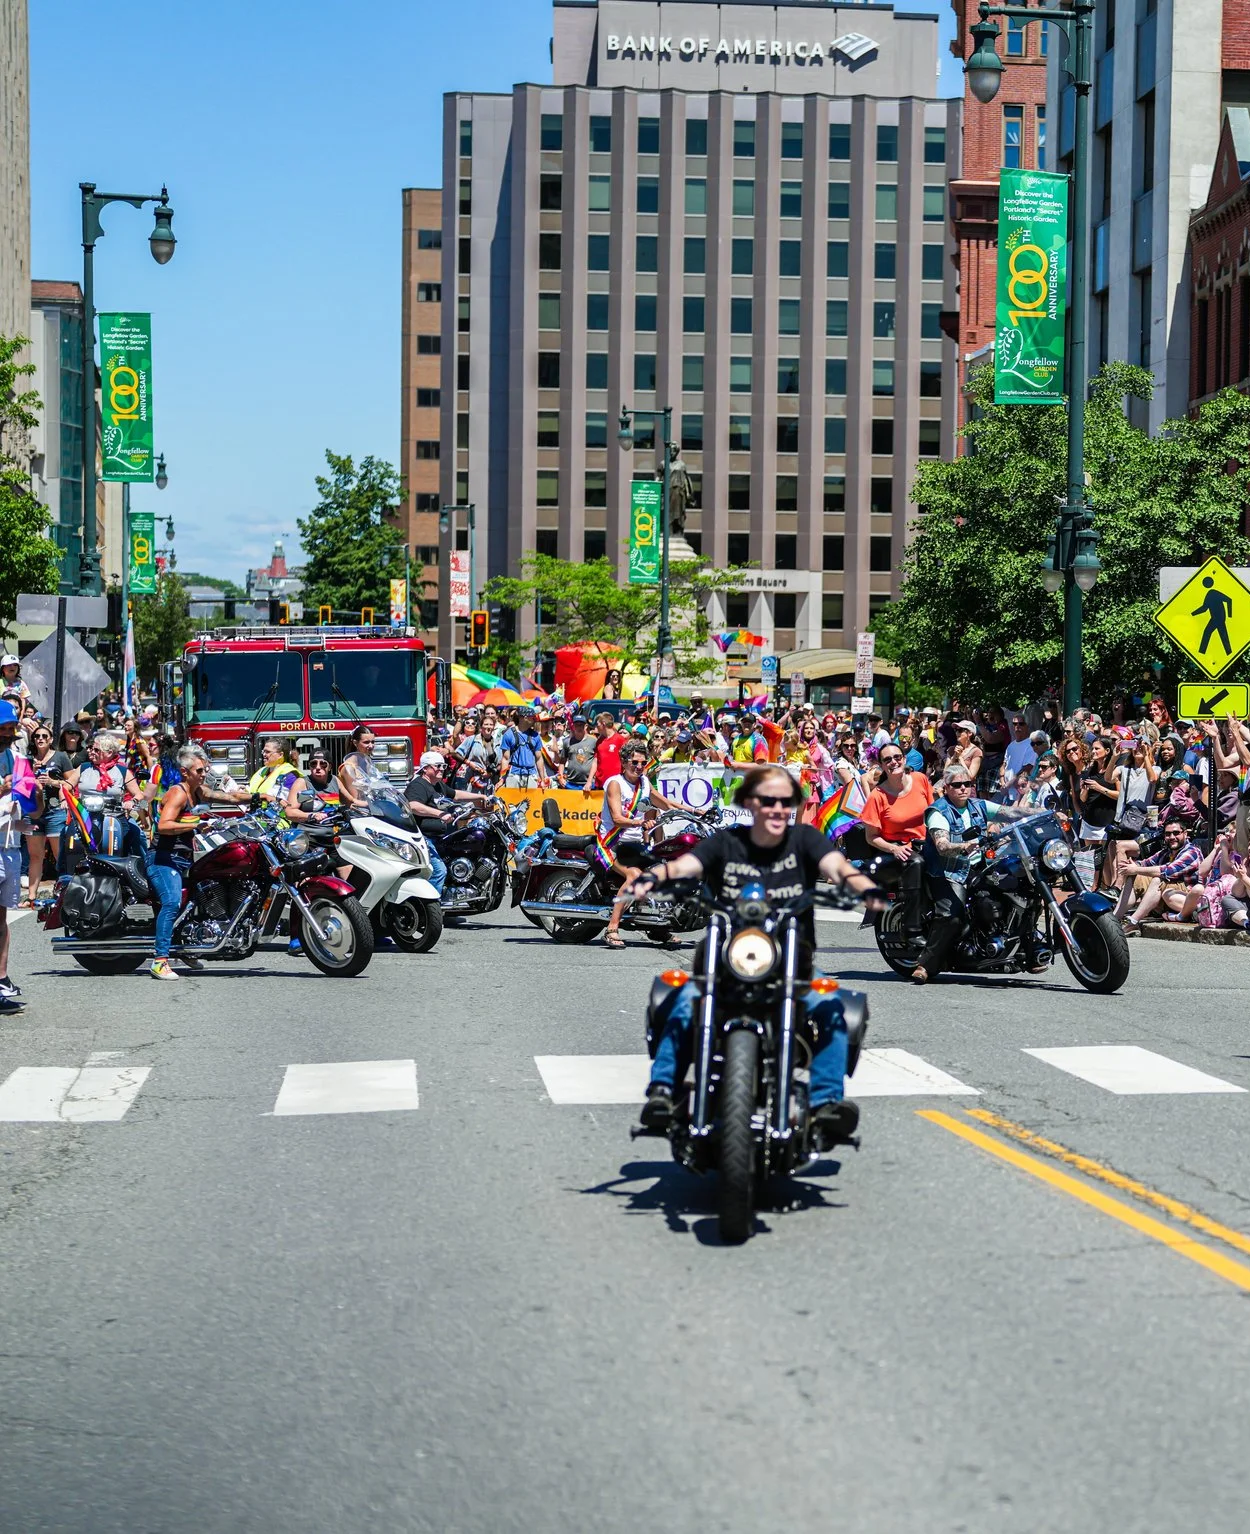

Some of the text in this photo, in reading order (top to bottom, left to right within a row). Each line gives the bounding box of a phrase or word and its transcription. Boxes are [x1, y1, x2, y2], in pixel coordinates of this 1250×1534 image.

[606, 34, 825, 59] BANK OF AMERICA
[1014, 189, 1054, 199] Discover the
[1003, 197, 1064, 208] Longfellow Garden,
[1003, 206, 1036, 214] Portland's
[1007, 214, 1059, 224] Historic Garden.
[1048, 249, 1059, 321] ANNIVERSARY
[139, 369, 147, 422] ANNIVERSARY
[756, 577, 787, 588] Square
[280, 722, 336, 731] PORTLAND
